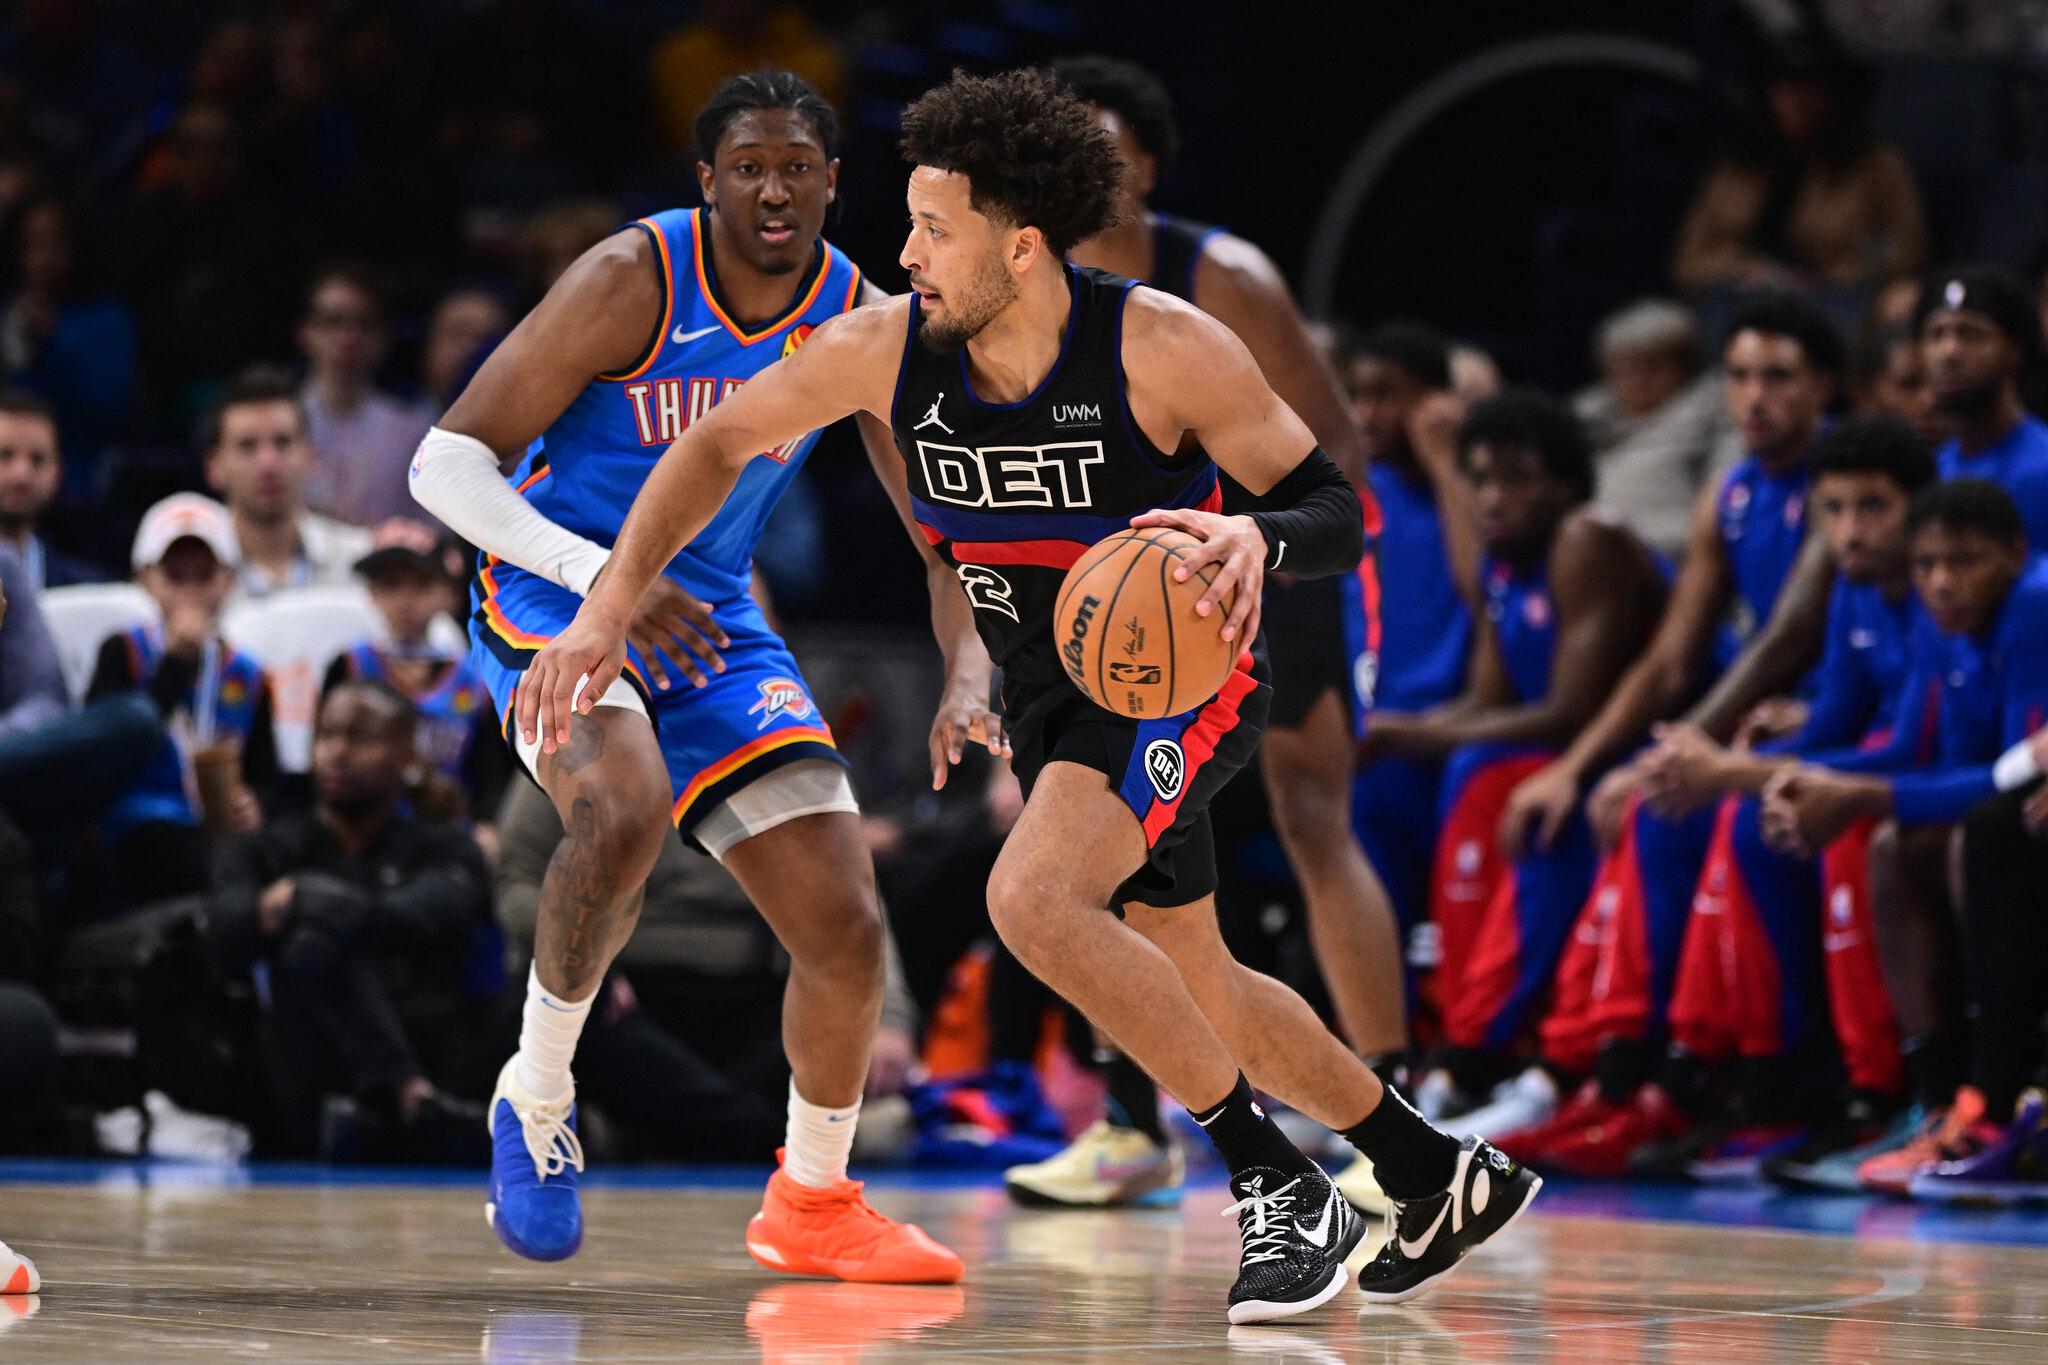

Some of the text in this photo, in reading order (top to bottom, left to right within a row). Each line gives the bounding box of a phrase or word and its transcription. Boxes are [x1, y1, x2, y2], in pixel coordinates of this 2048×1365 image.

[1052, 403, 1102, 423] UWM
[916, 440, 1105, 508] DET
[957, 563, 1020, 623] 2
[1152, 749, 1179, 788] DET
